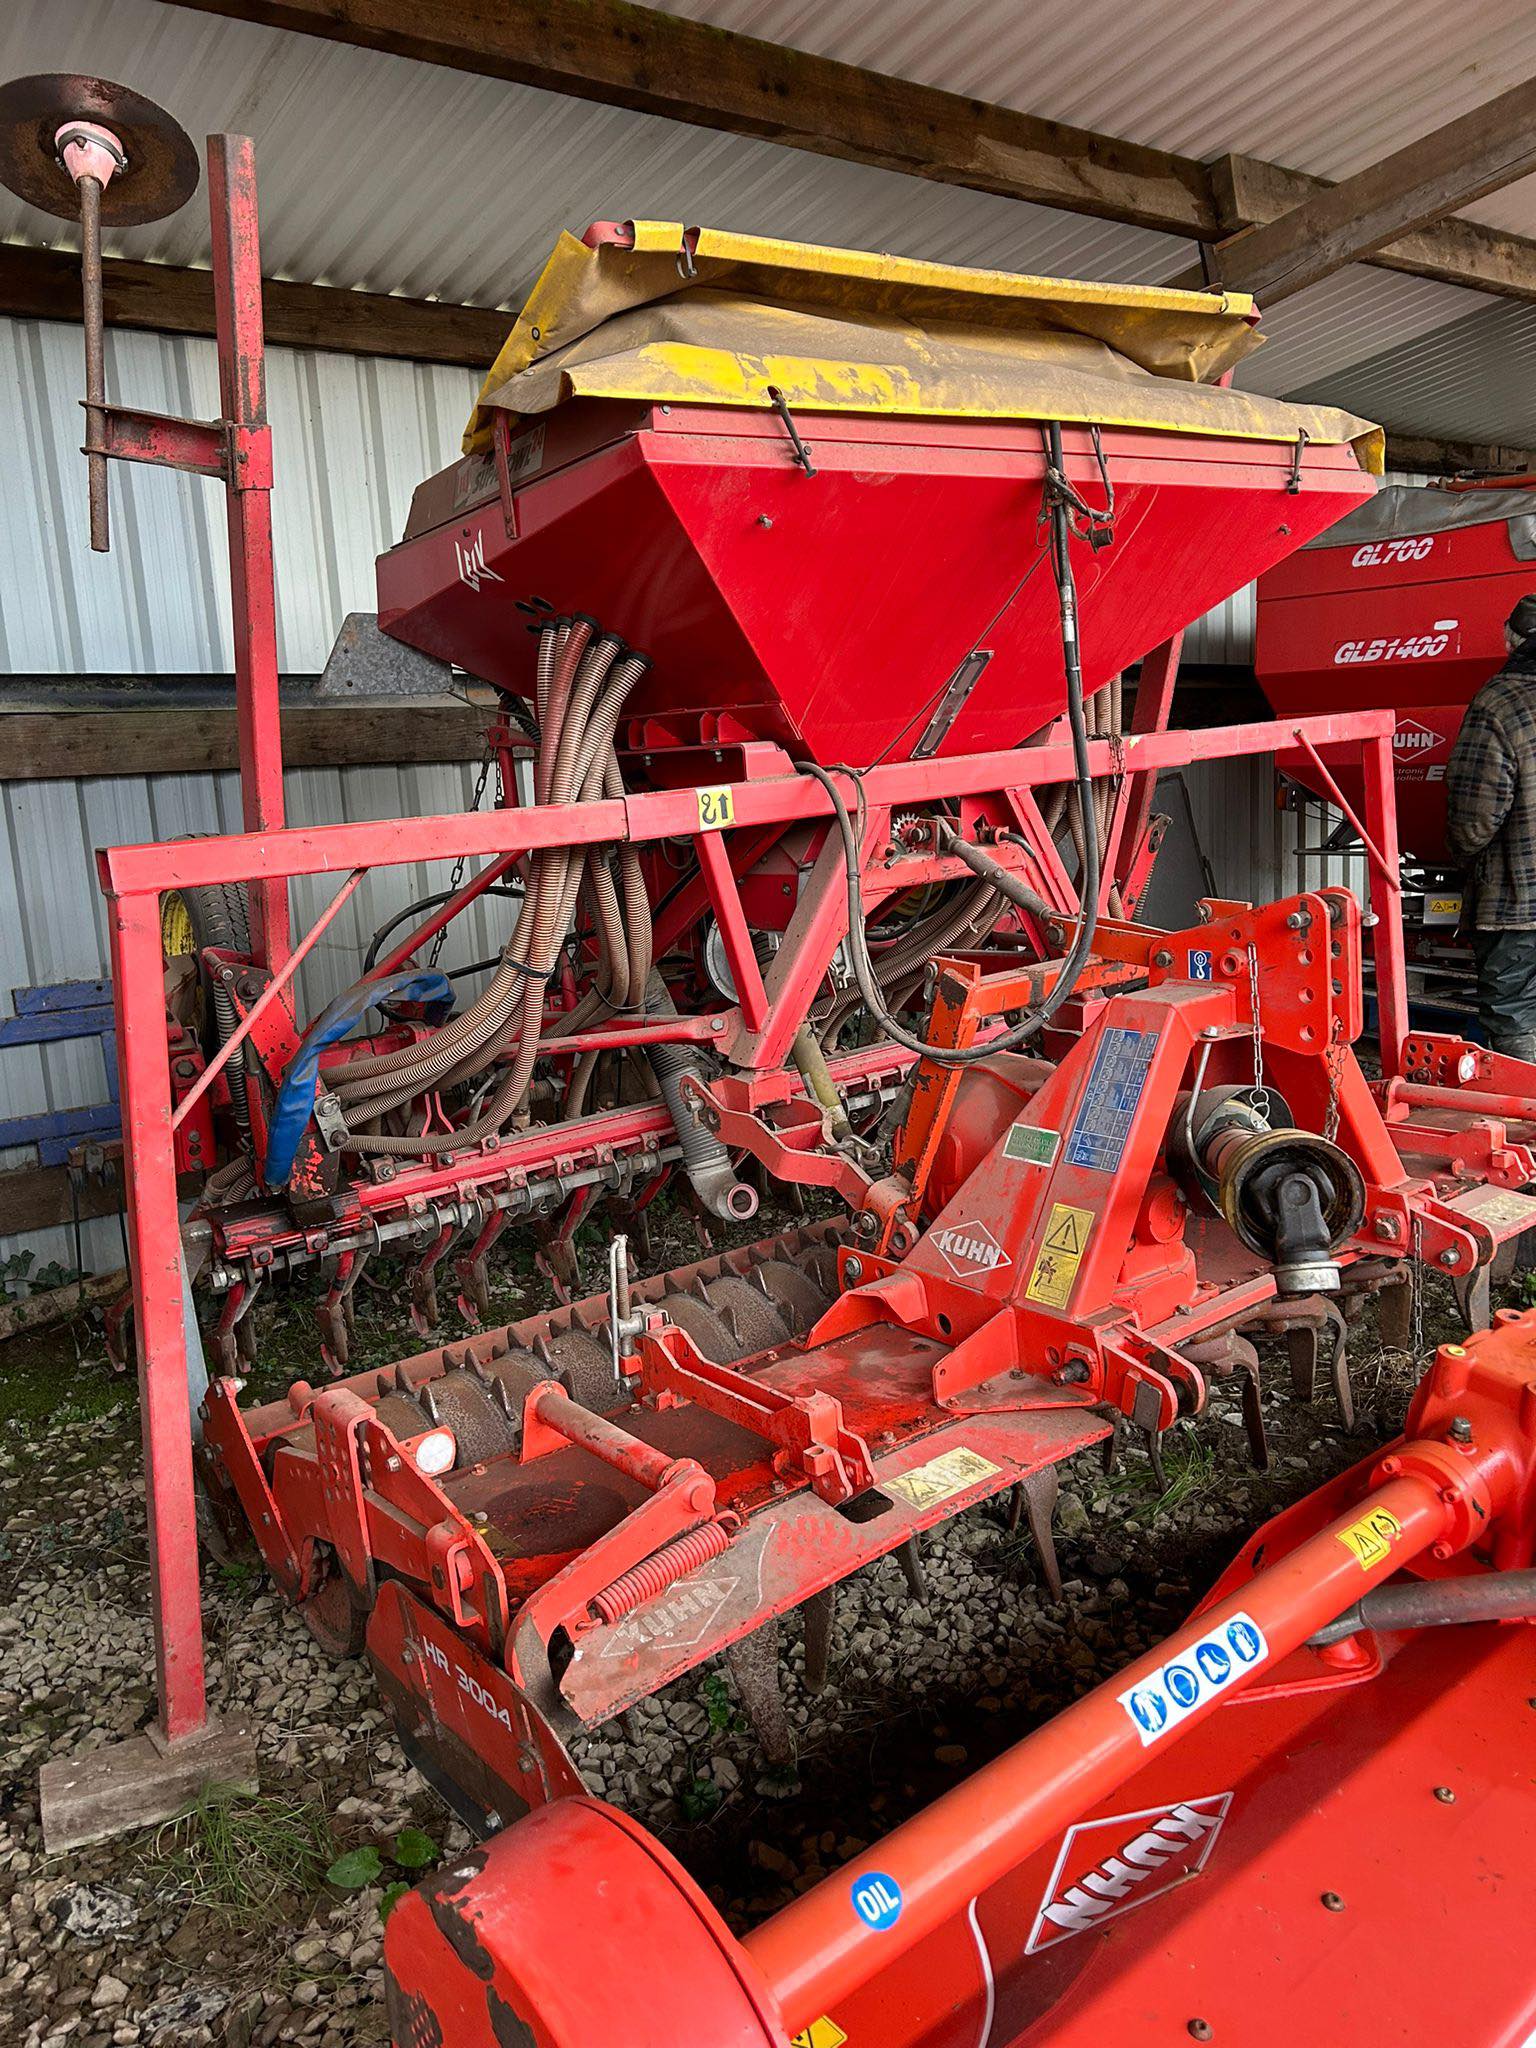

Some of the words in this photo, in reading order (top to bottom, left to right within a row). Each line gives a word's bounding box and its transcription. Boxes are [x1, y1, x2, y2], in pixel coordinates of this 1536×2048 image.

[1352, 537, 1434, 567] GL700
[1333, 634, 1449, 665] GLB1400
[1393, 733, 1434, 748] UHN
[939, 1230, 1002, 1268] KUHN
[615, 1581, 727, 1644] KUHN
[423, 1635, 451, 1676] HR
[454, 1663, 512, 1733] 3004
[1041, 1804, 1224, 1931] KUHN
[857, 1881, 899, 1921] OIL
